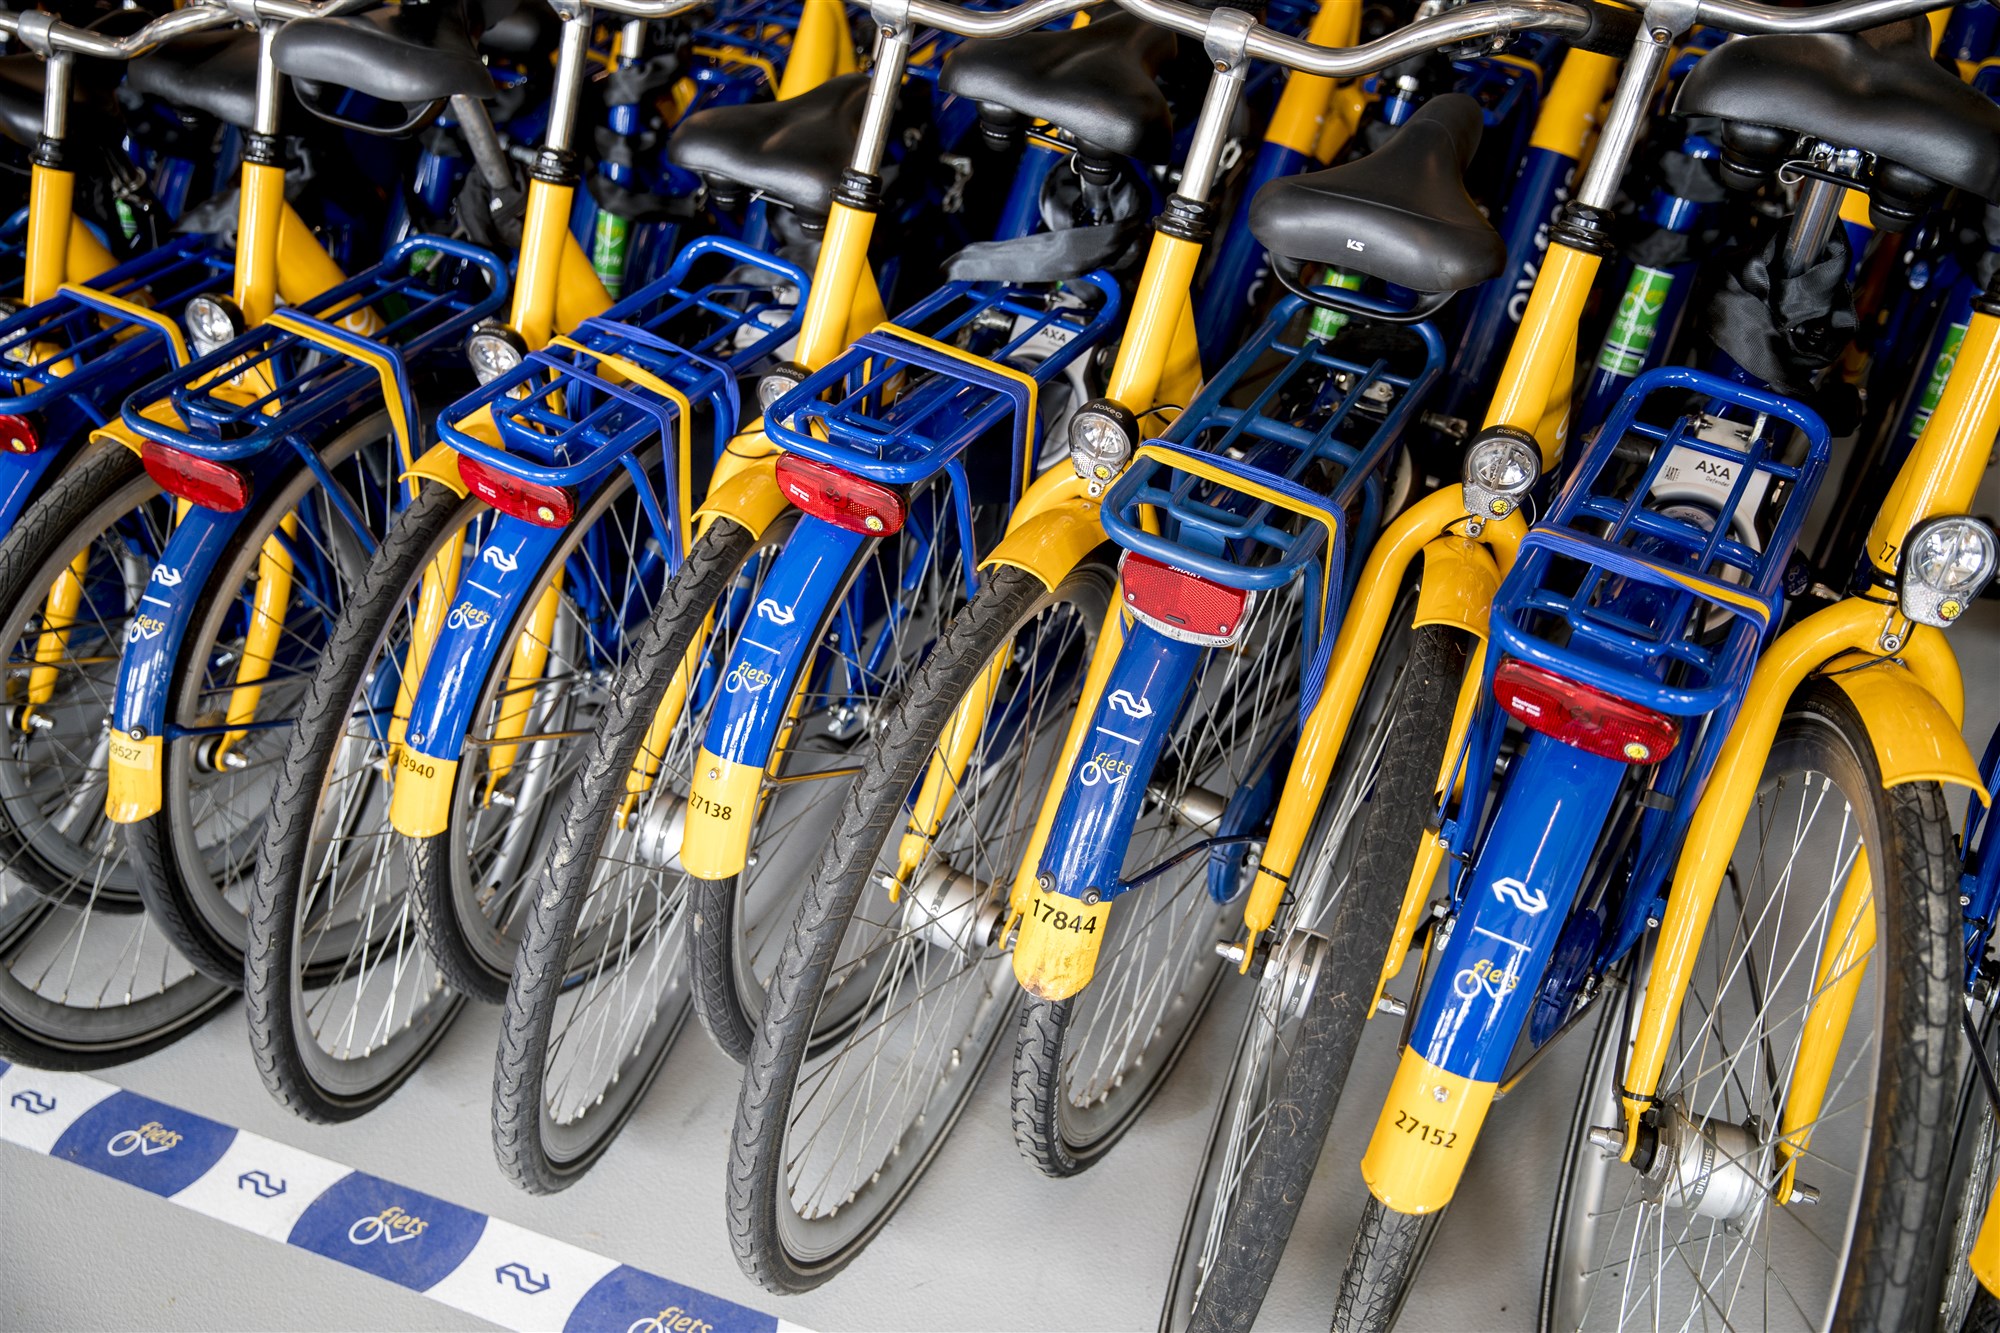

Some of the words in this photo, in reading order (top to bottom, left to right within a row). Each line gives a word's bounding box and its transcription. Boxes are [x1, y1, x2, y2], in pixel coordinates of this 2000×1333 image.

[1346, 238, 1365, 251] KS
[1041, 327, 1066, 343] AXA
[1695, 460, 1731, 481] AXA
[133, 613, 165, 633] fiets
[454, 601, 491, 625] fiets
[732, 661, 771, 685] fiets
[1089, 752, 1133, 775] fiets
[691, 791, 732, 821] 27138
[1033, 898, 1097, 934] 17844
[1466, 959, 1520, 990] fies
[124, 1121, 183, 1148] fiets
[1395, 1110, 1457, 1149] 27152
[365, 1206, 429, 1235] fiets
